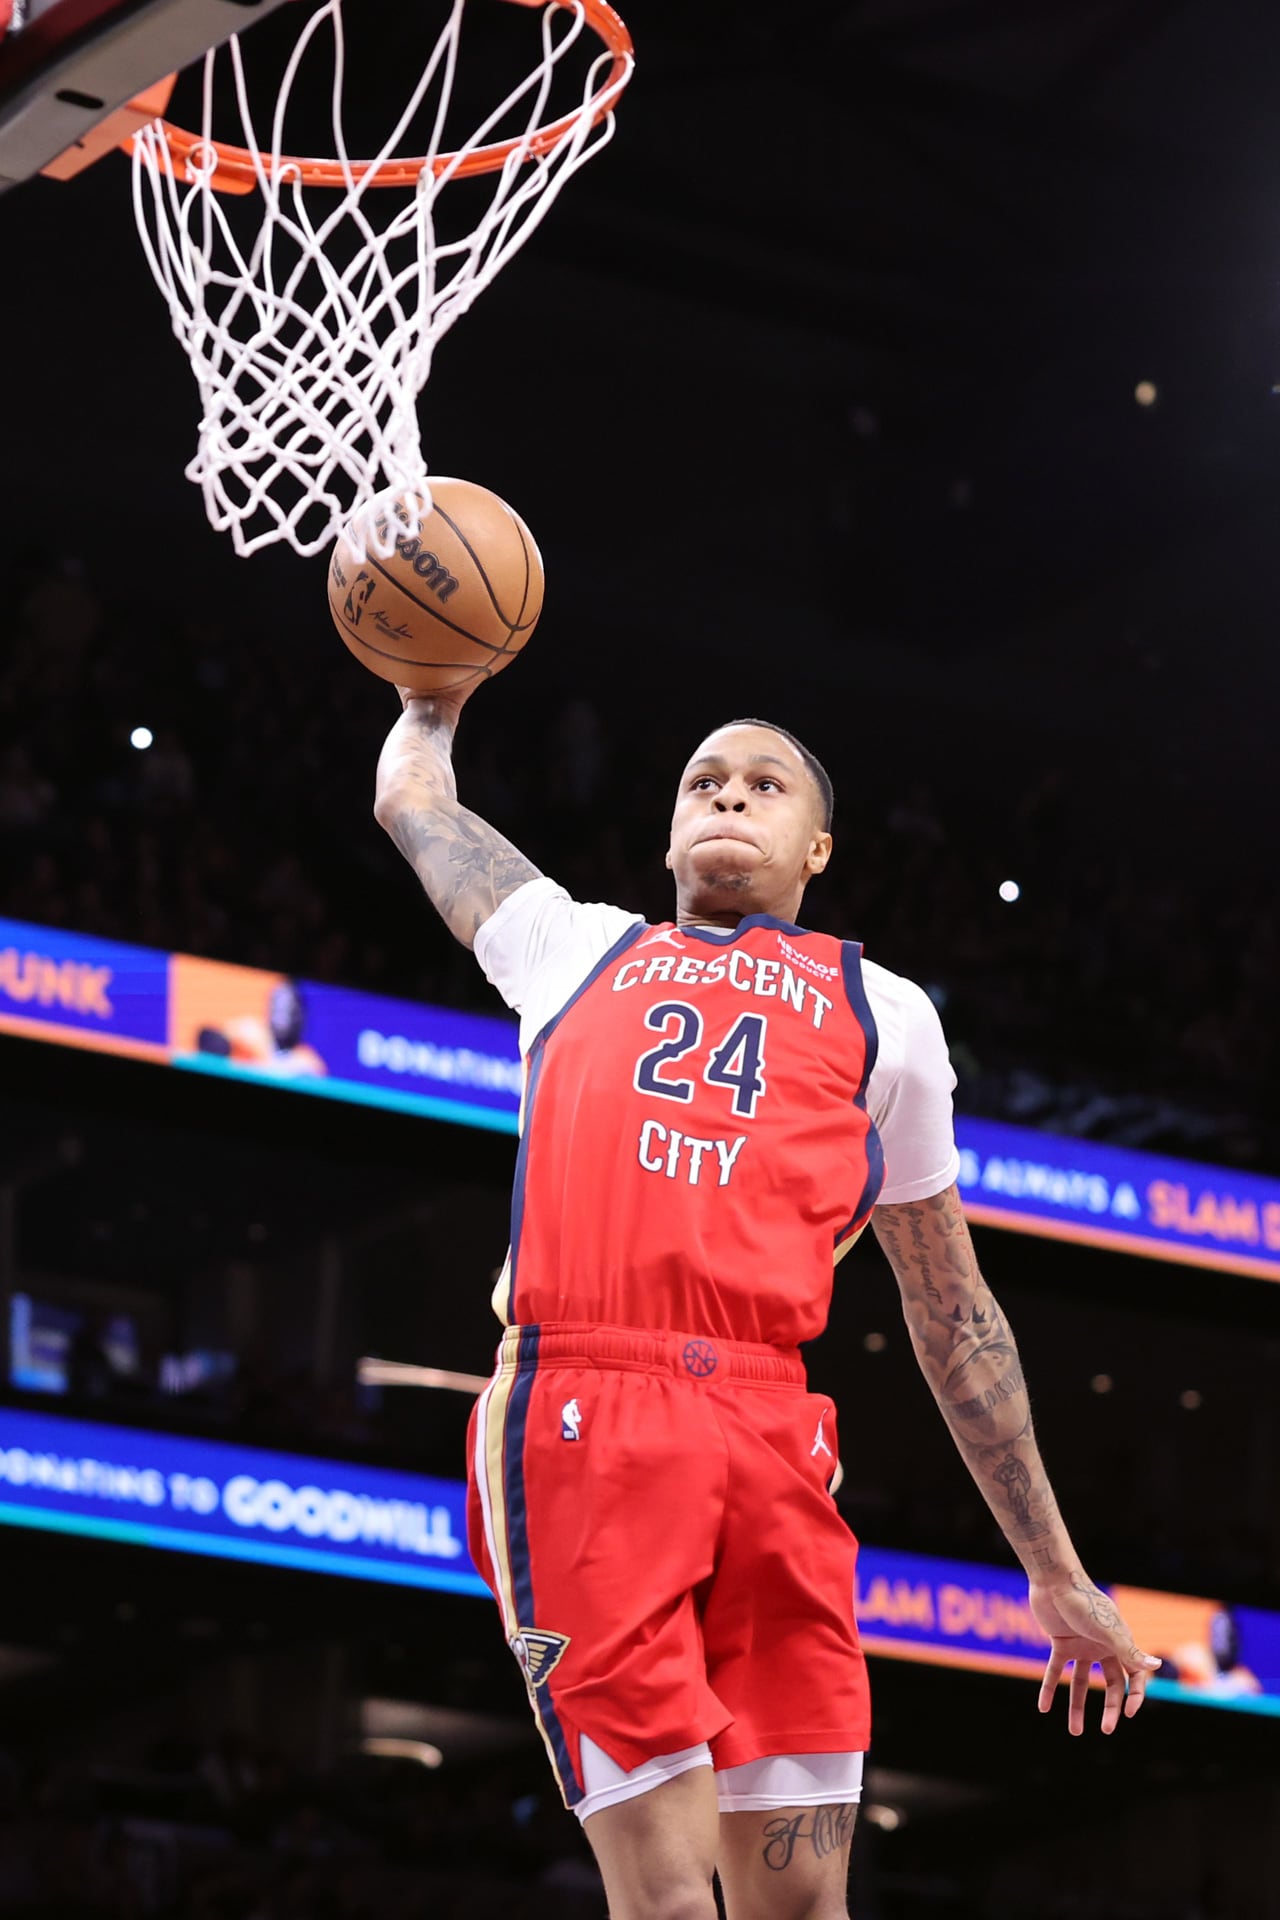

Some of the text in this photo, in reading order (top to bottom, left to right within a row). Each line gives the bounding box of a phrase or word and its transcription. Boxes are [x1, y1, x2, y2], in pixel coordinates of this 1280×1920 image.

[0, 947, 113, 1019] UNK
[611, 949, 834, 1030] CRESCENT
[776, 934, 839, 977] NEWAGE
[780, 948, 833, 982] PRODUCTS
[633, 1000, 767, 1119] 24
[638, 1119, 748, 1187] CITY
[1148, 1180, 1260, 1247] SLAM
[168, 1472, 220, 1515] TO
[222, 1475, 463, 1560] GOODWILL
[937, 1583, 1053, 1649] DUN
